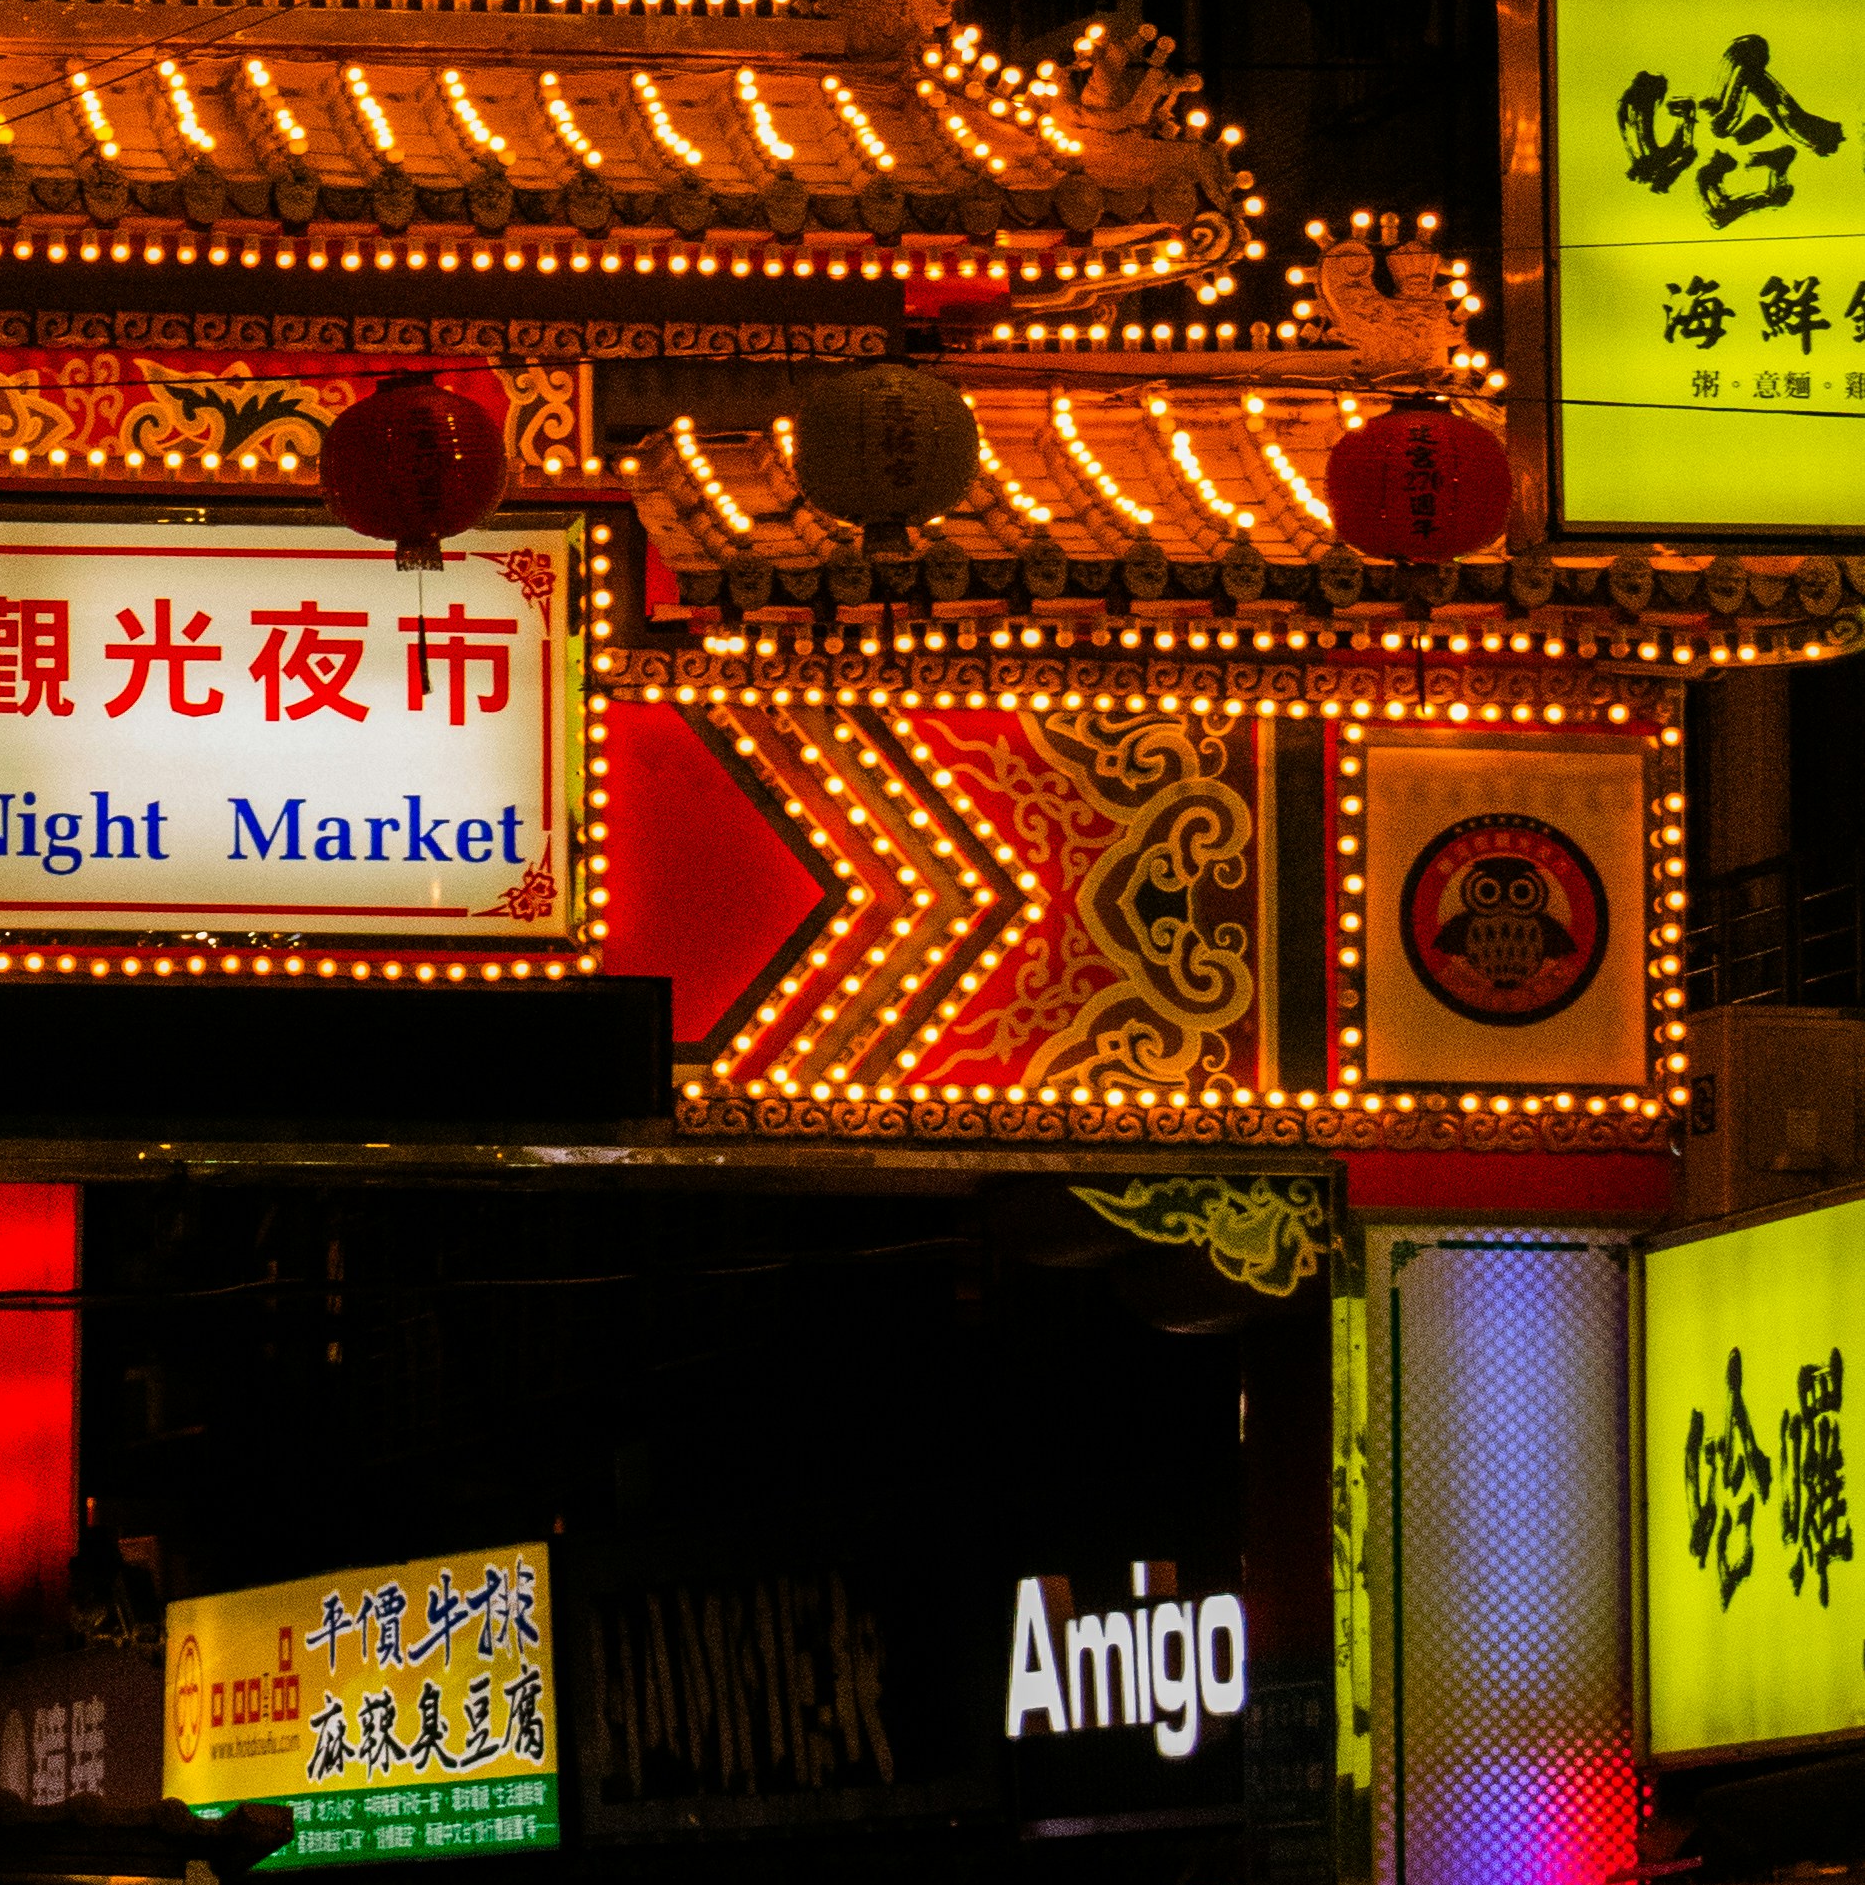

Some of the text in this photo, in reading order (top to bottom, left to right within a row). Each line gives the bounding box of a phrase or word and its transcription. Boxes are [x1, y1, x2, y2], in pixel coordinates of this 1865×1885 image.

[227, 795, 525, 865] Market
[305, 1554, 540, 1676] 平價牛排
[1006, 1560, 1247, 1761] Amigo
[305, 1660, 546, 1783] 麻辣臭豆腐
